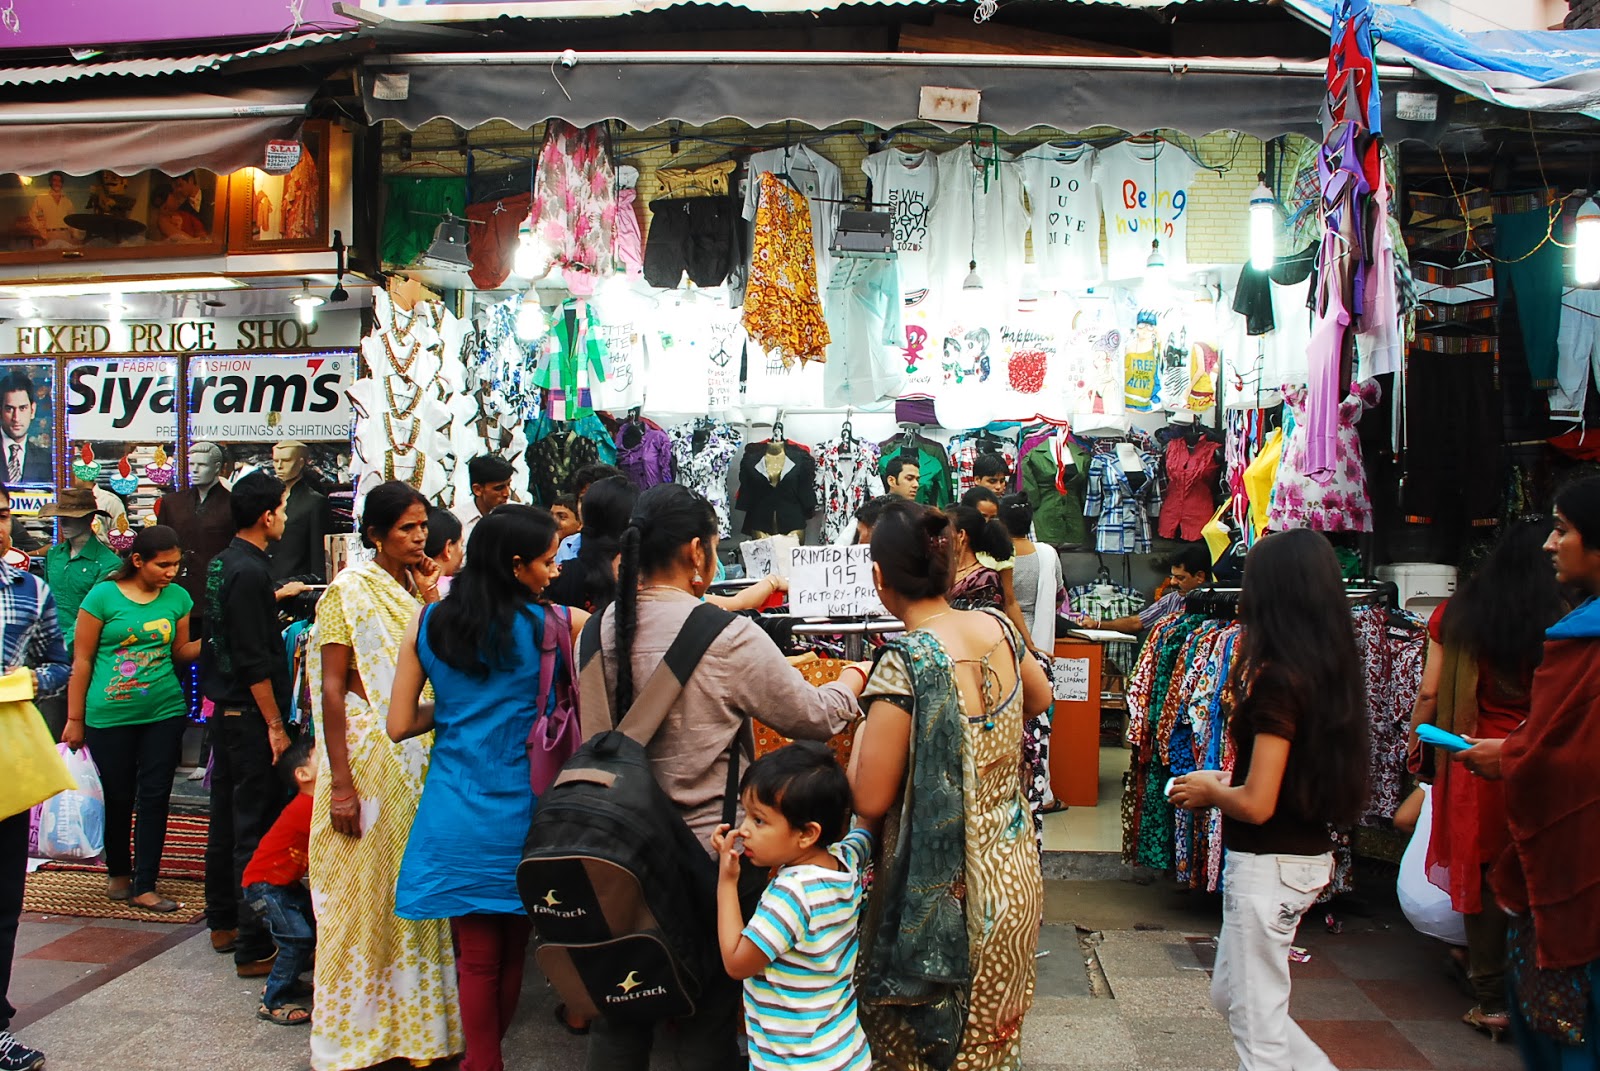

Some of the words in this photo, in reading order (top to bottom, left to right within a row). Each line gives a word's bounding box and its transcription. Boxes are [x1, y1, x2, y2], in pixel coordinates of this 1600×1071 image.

[1058, 195, 1067, 208] U
[1122, 179, 1186, 220] Being
[1116, 214, 1174, 238] human
[1049, 232, 1071, 246] ME
[15, 325, 110, 353] FIXED
[130, 322, 216, 352] PRICE
[237, 319, 318, 349] SHOP
[1132, 359, 1154, 371] FREE
[68, 358, 341, 428] Siyaram's
[156, 425, 219, 436] PREMIUM
[222, 424, 273, 436] SUITINGS
[276, 425, 284, 435] &
[288, 424, 348, 436] SHIRTINGS
[792, 547, 842, 567] PRINTED
[846, 546, 871, 564] KUR
[824, 565, 857, 587] 195
[855, 586, 876, 599] PRIC
[533, 904, 587, 918] fastrack
[605, 985, 667, 1003] fastrack
